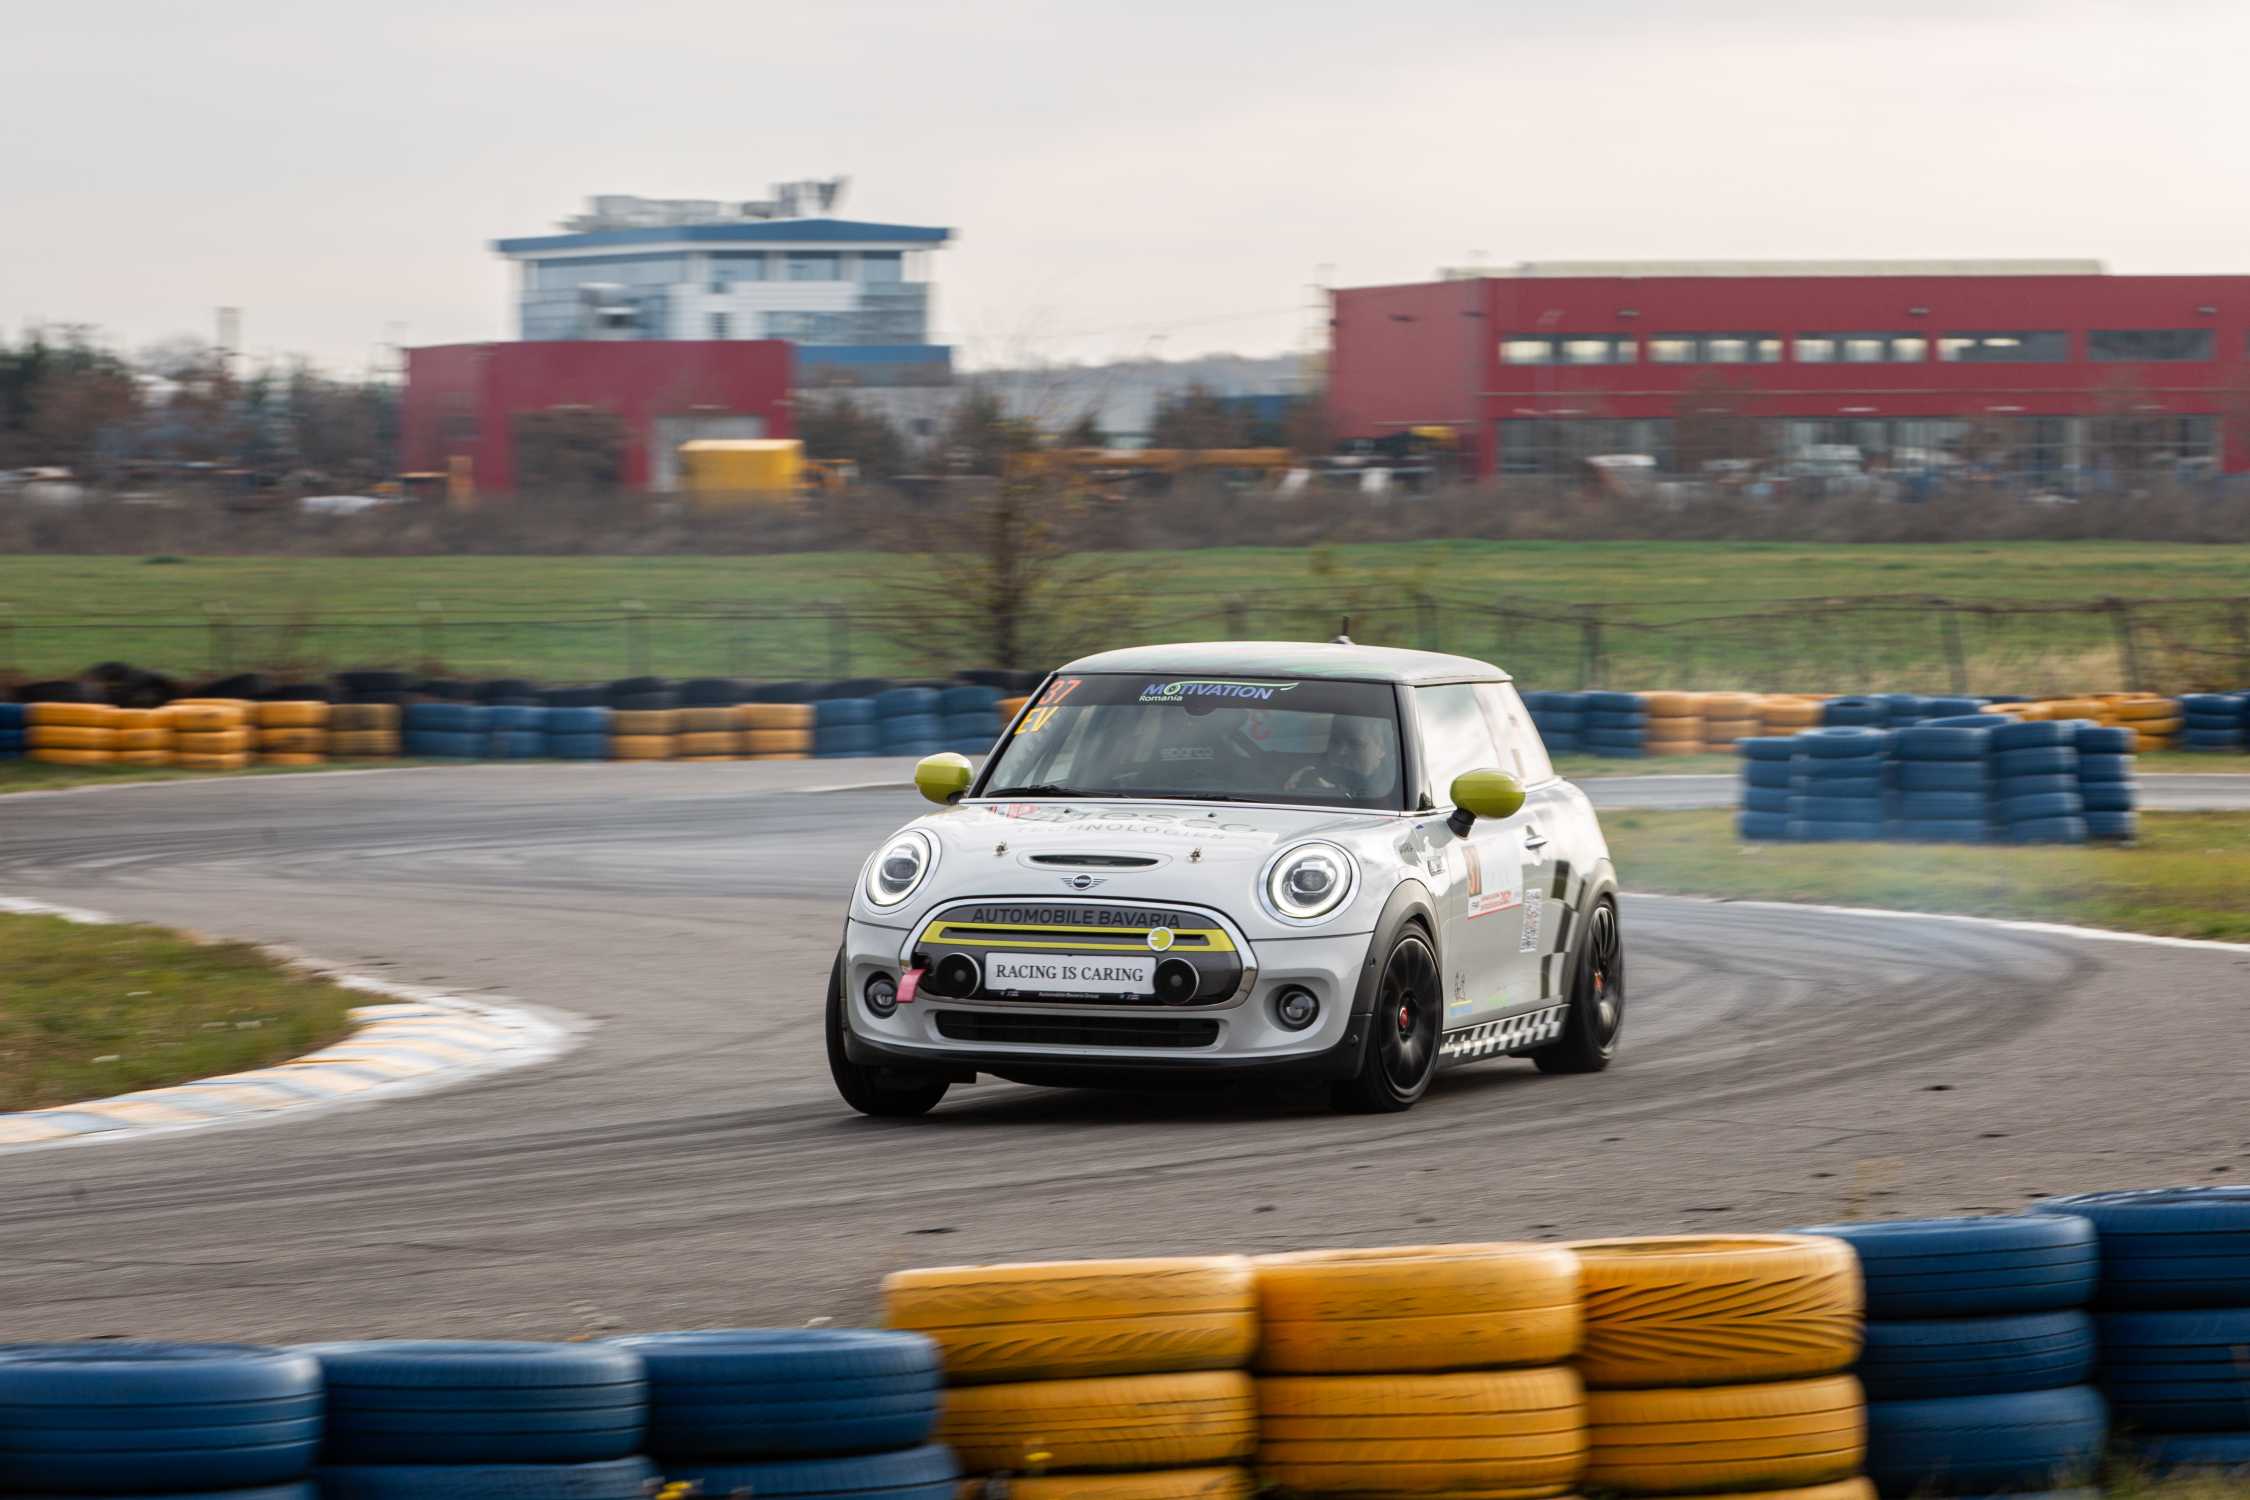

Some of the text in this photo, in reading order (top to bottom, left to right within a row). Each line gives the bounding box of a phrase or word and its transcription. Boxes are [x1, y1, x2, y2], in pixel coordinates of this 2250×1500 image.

[1138, 694, 1184, 702] Romania
[1143, 682, 1275, 700] MOTIVATION
[1014, 706, 1060, 735] EV
[971, 907, 1181, 928] AUTOMOBILE BAVARIA
[995, 964, 1144, 982] RACING IS CARING
